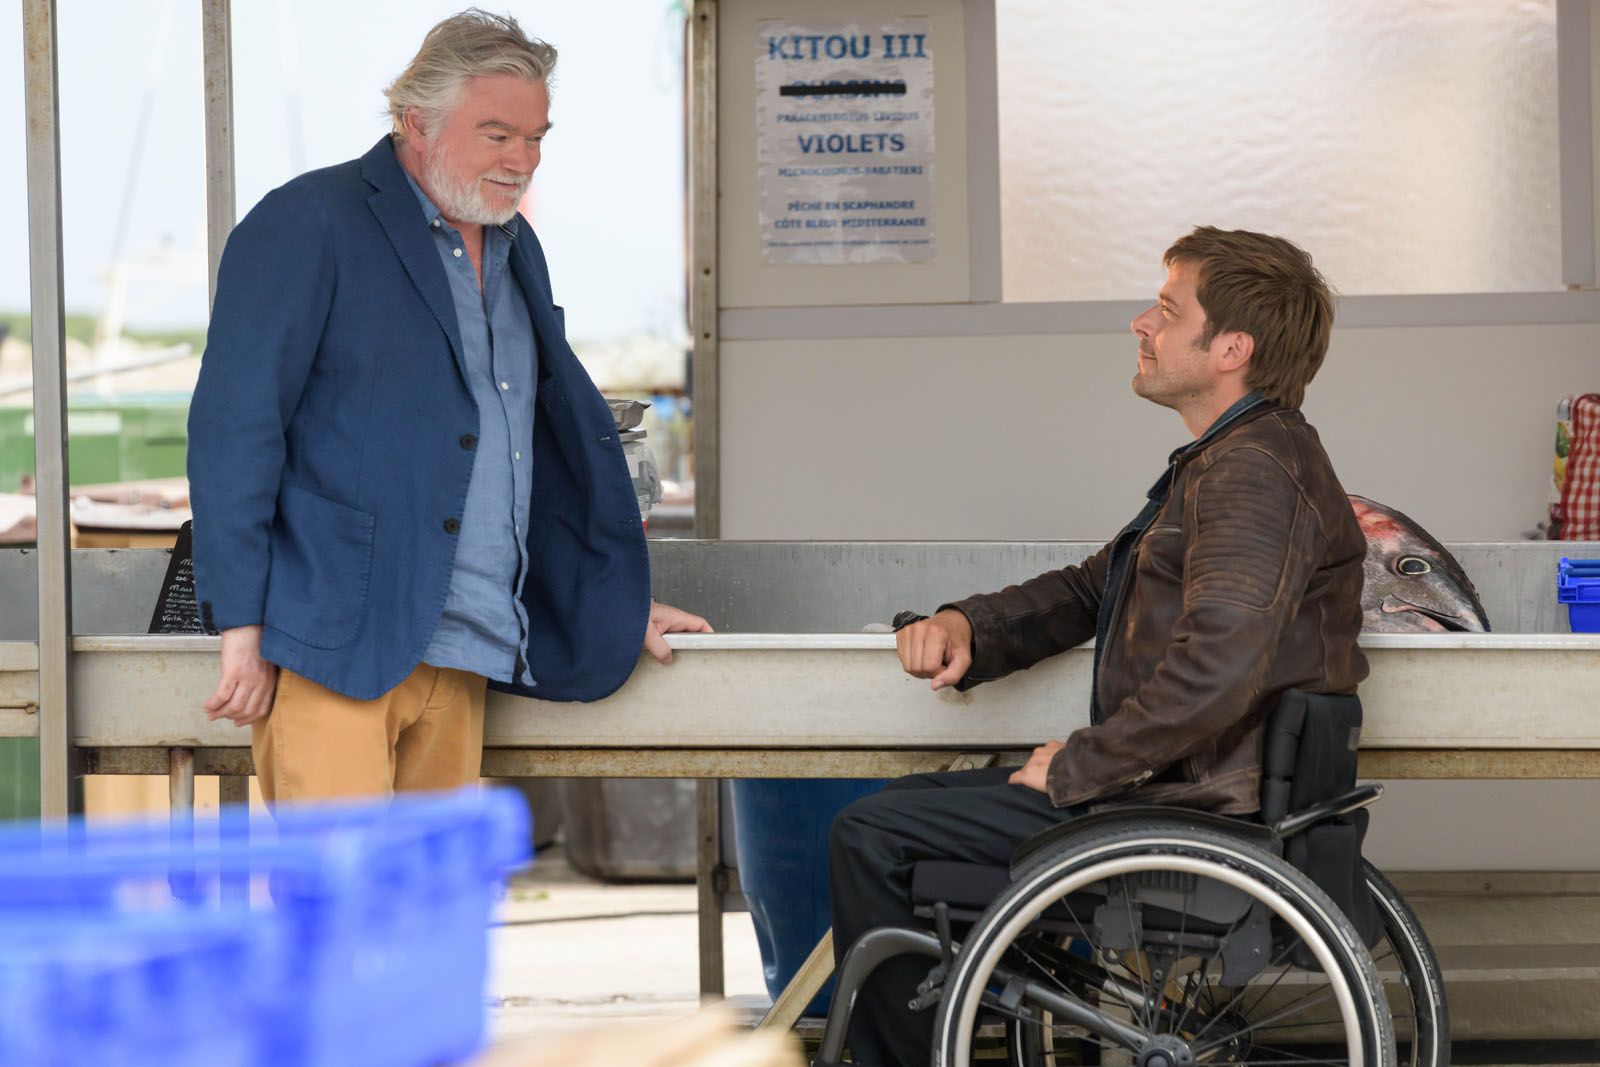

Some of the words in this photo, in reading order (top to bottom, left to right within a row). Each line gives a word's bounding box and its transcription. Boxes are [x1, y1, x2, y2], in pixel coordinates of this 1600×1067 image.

[768, 34, 871, 60] KITOU
[882, 34, 927, 58] III
[798, 133, 905, 154] VIOLETS
[825, 201, 841, 211] EN
[843, 200, 915, 211] SCAPHANDRE
[774, 216, 801, 230] CÔTE
